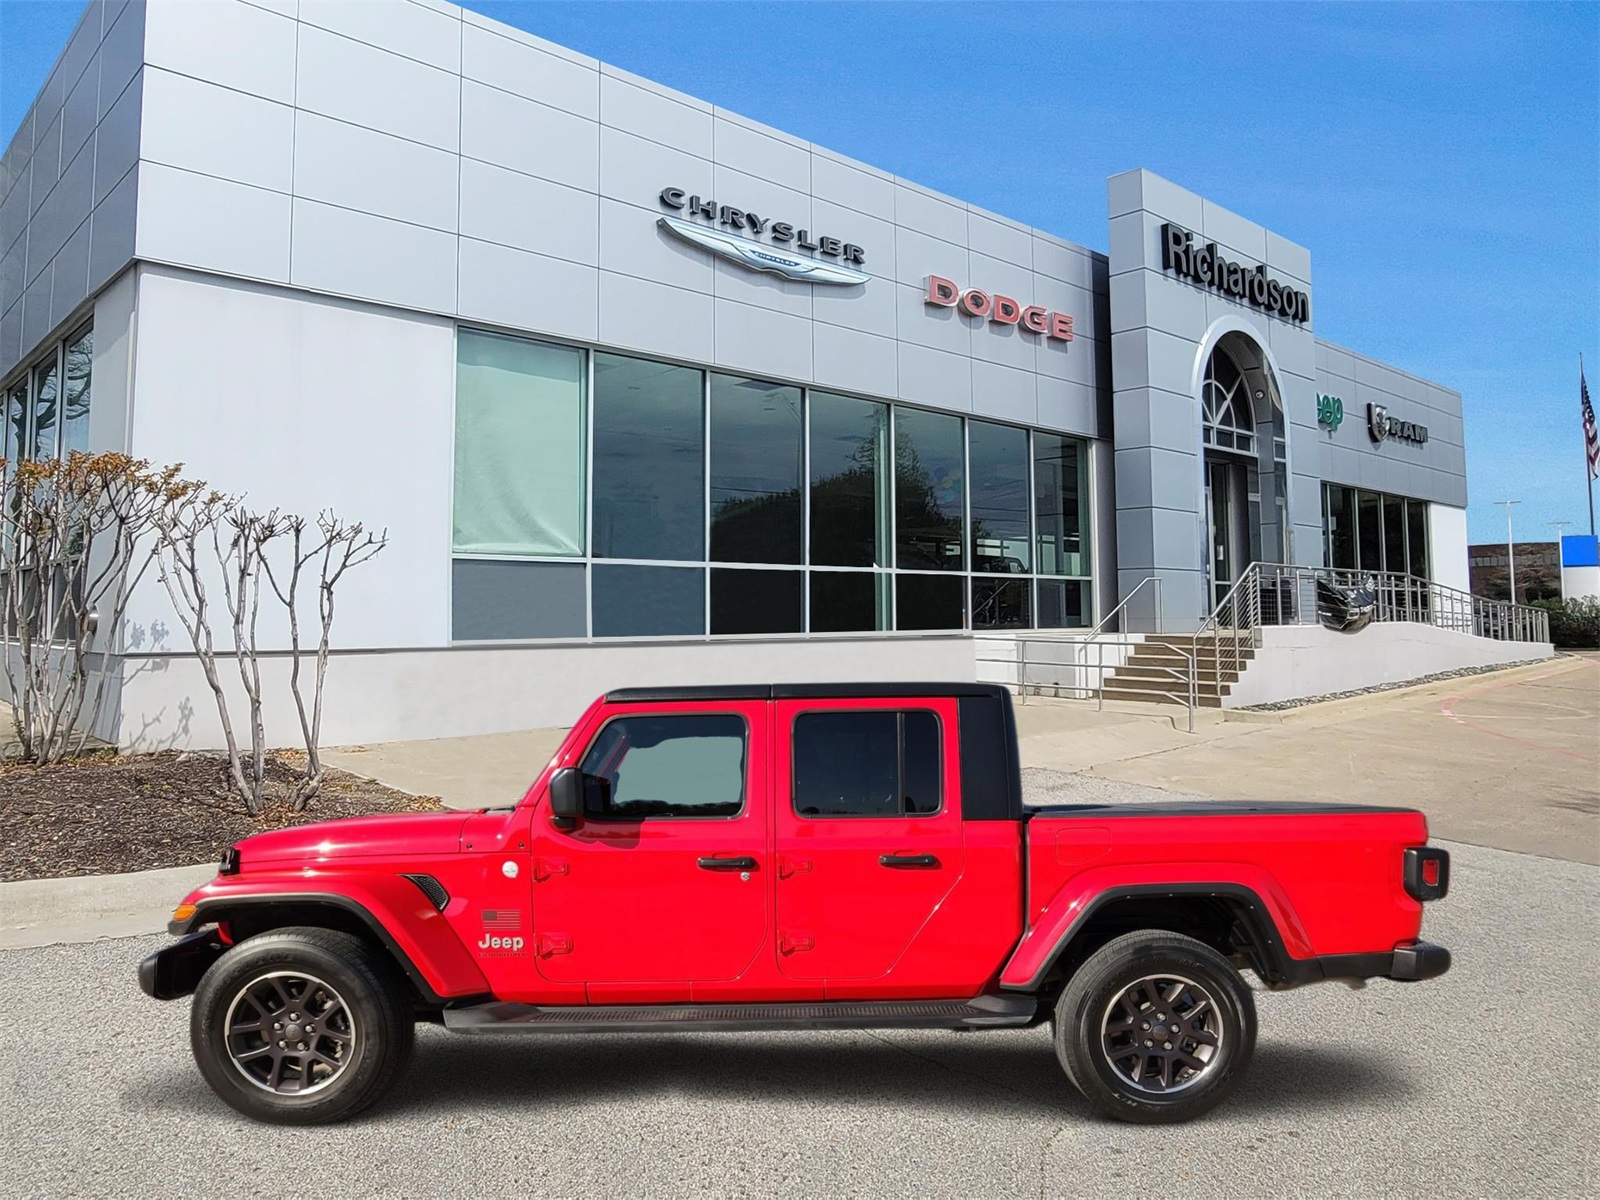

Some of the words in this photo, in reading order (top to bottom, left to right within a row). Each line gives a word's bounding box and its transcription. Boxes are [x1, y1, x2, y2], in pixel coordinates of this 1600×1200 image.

[659, 187, 866, 264] CHRYSLER
[1161, 223, 1310, 323] Richardson
[923, 275, 1074, 342] DODGE
[1386, 416, 1429, 443] RAM
[478, 933, 525, 951] Jeep
